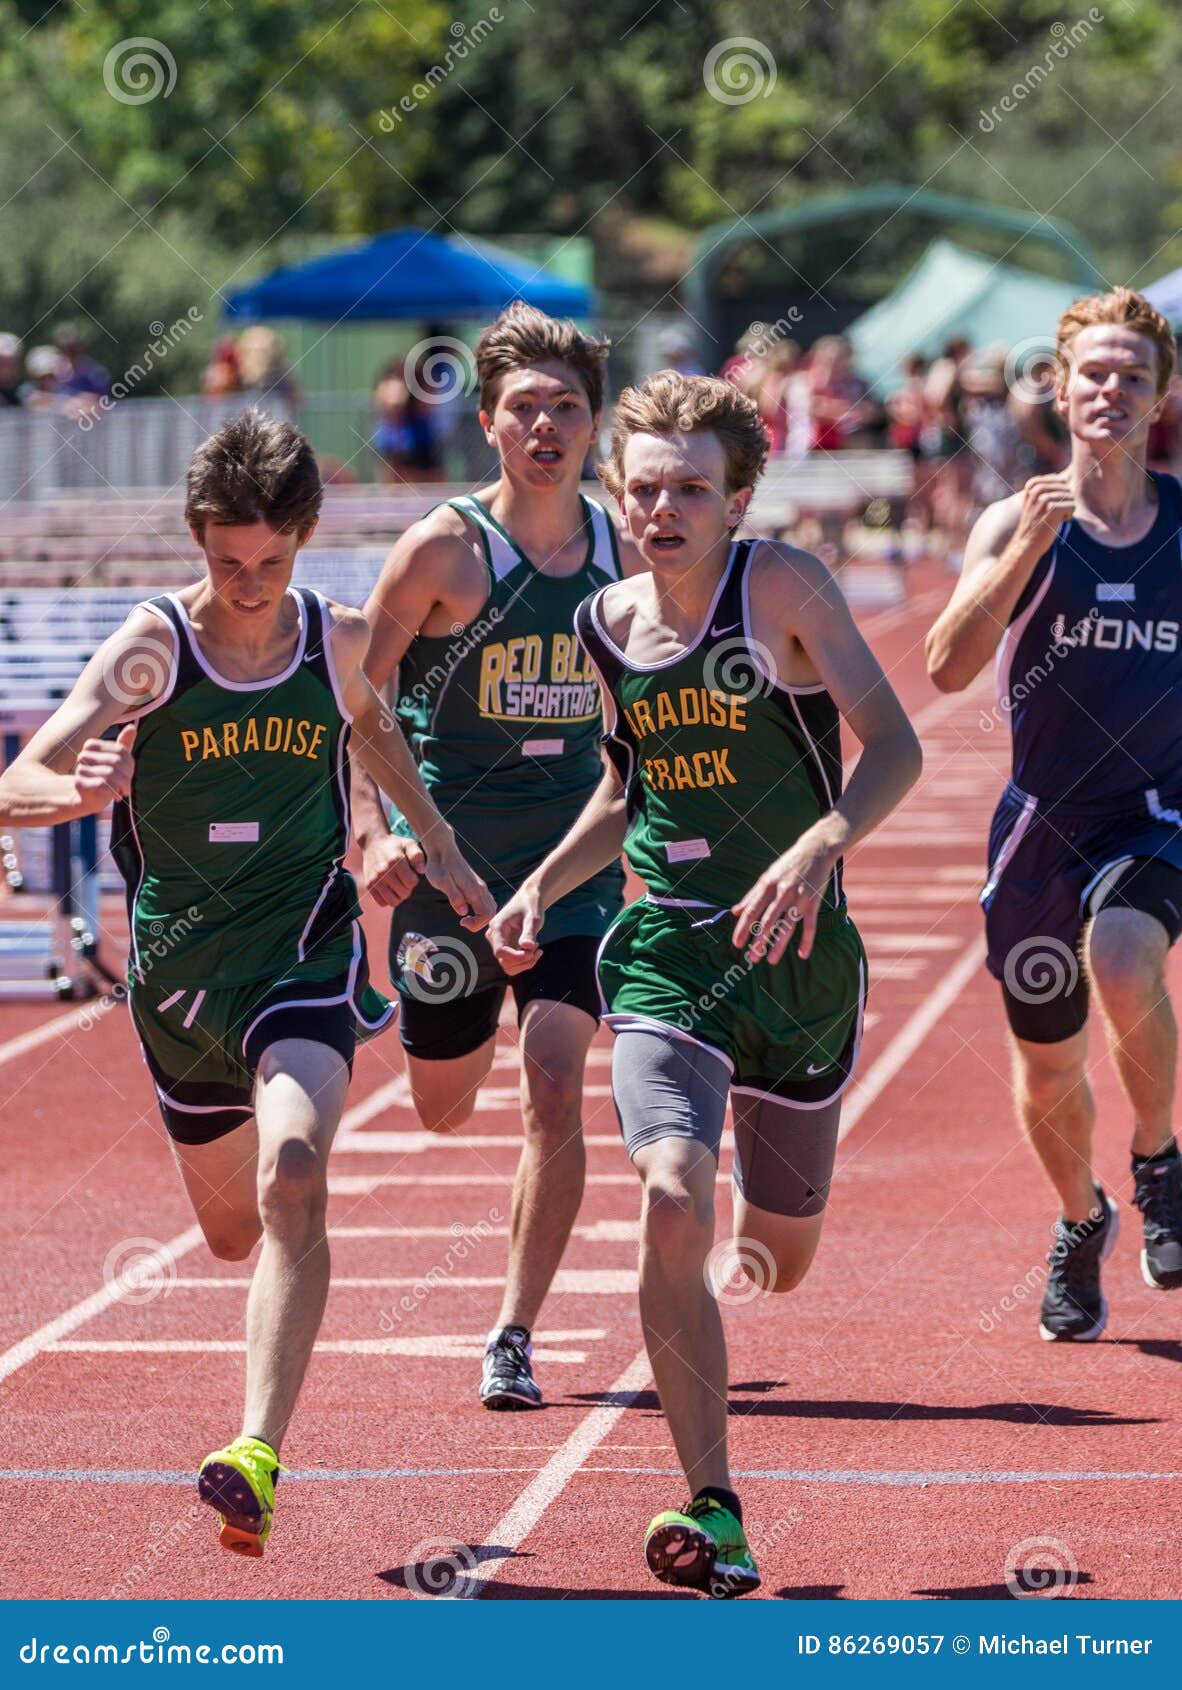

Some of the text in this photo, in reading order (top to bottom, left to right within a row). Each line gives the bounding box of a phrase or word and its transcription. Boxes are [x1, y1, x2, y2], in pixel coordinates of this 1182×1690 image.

[1055, 613, 1180, 653] LIONS
[479, 635, 543, 713] RED
[180, 716, 327, 762] PARADISE
